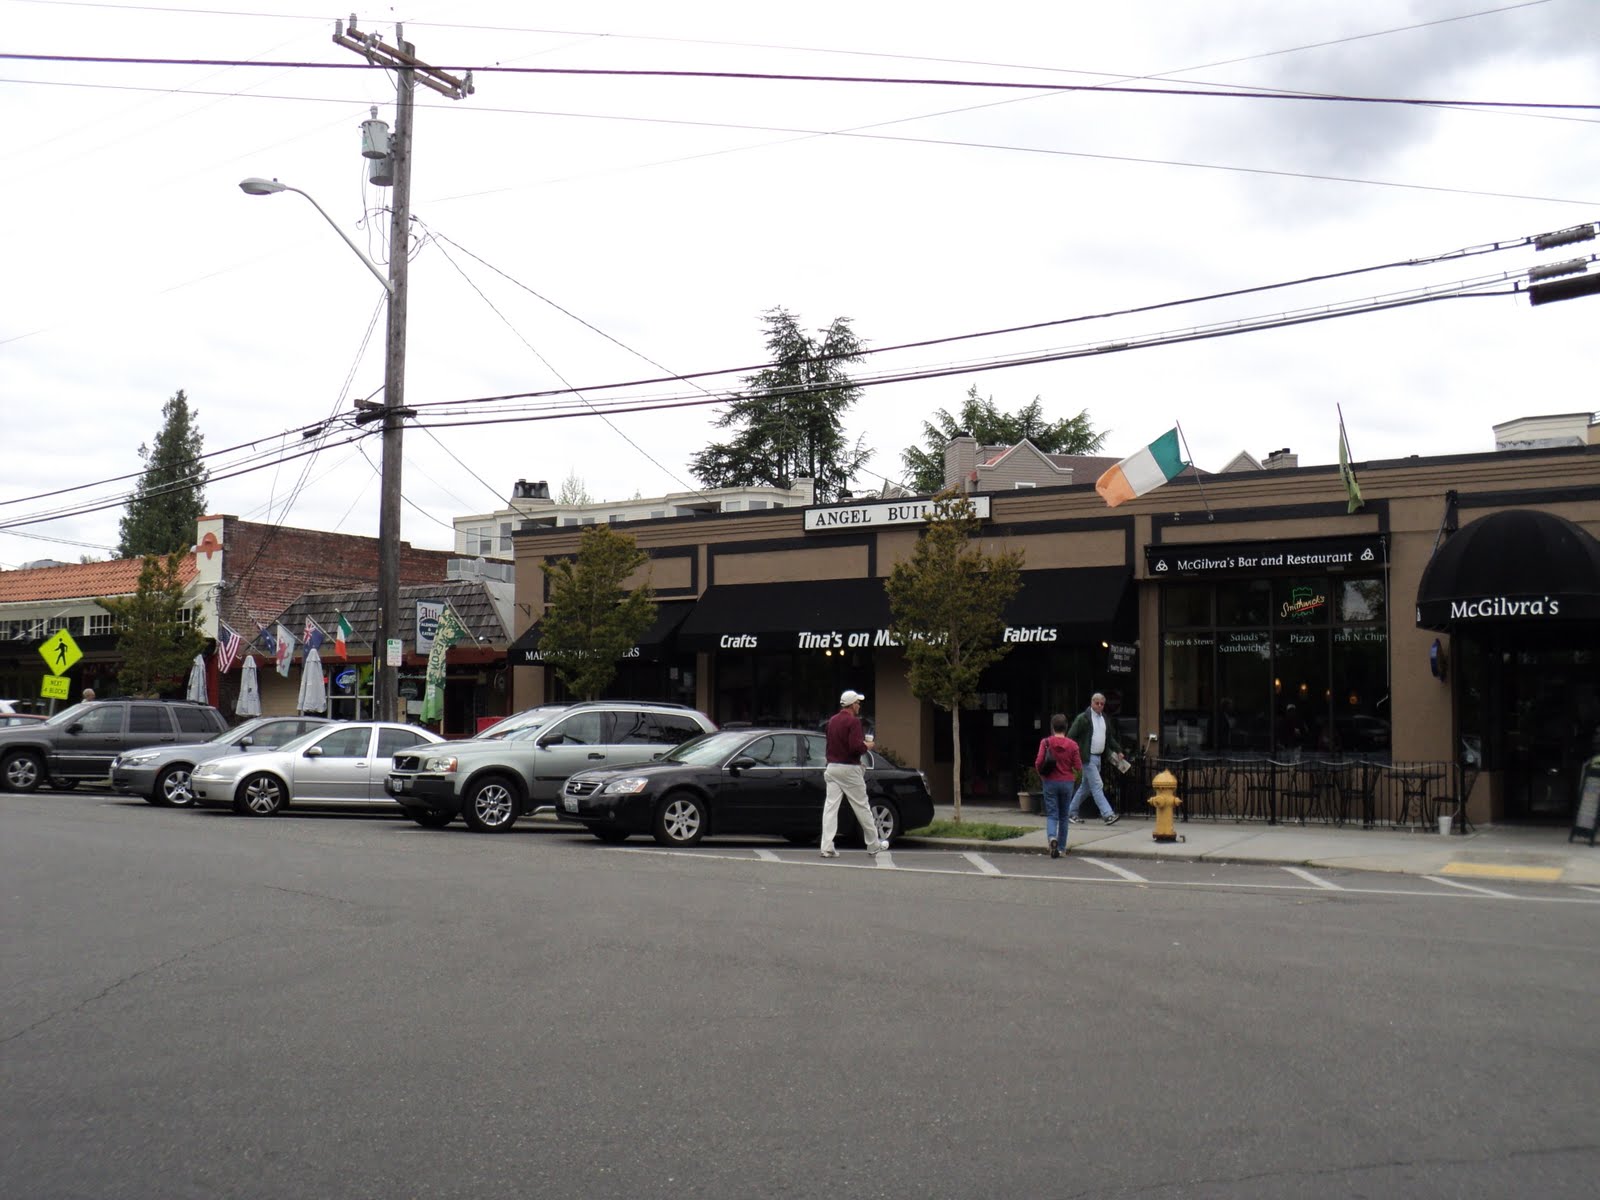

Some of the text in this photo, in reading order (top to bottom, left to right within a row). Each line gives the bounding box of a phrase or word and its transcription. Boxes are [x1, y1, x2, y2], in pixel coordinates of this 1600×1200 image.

[815, 509, 871, 526] ANGEL
[1177, 552, 1353, 571] McGilvra's Bar and Restaurant
[1280, 594, 1326, 618] Smithwick's
[1450, 596, 1559, 619] McGilvra's
[720, 634, 757, 649] Crafts
[798, 630, 843, 649] Tina's
[848, 632, 869, 648] on
[1003, 627, 1057, 643] Fabrics
[1230, 632, 1259, 642] Salads
[1290, 633, 1315, 643] Pizza
[1219, 643, 1270, 653] Sandwiches
